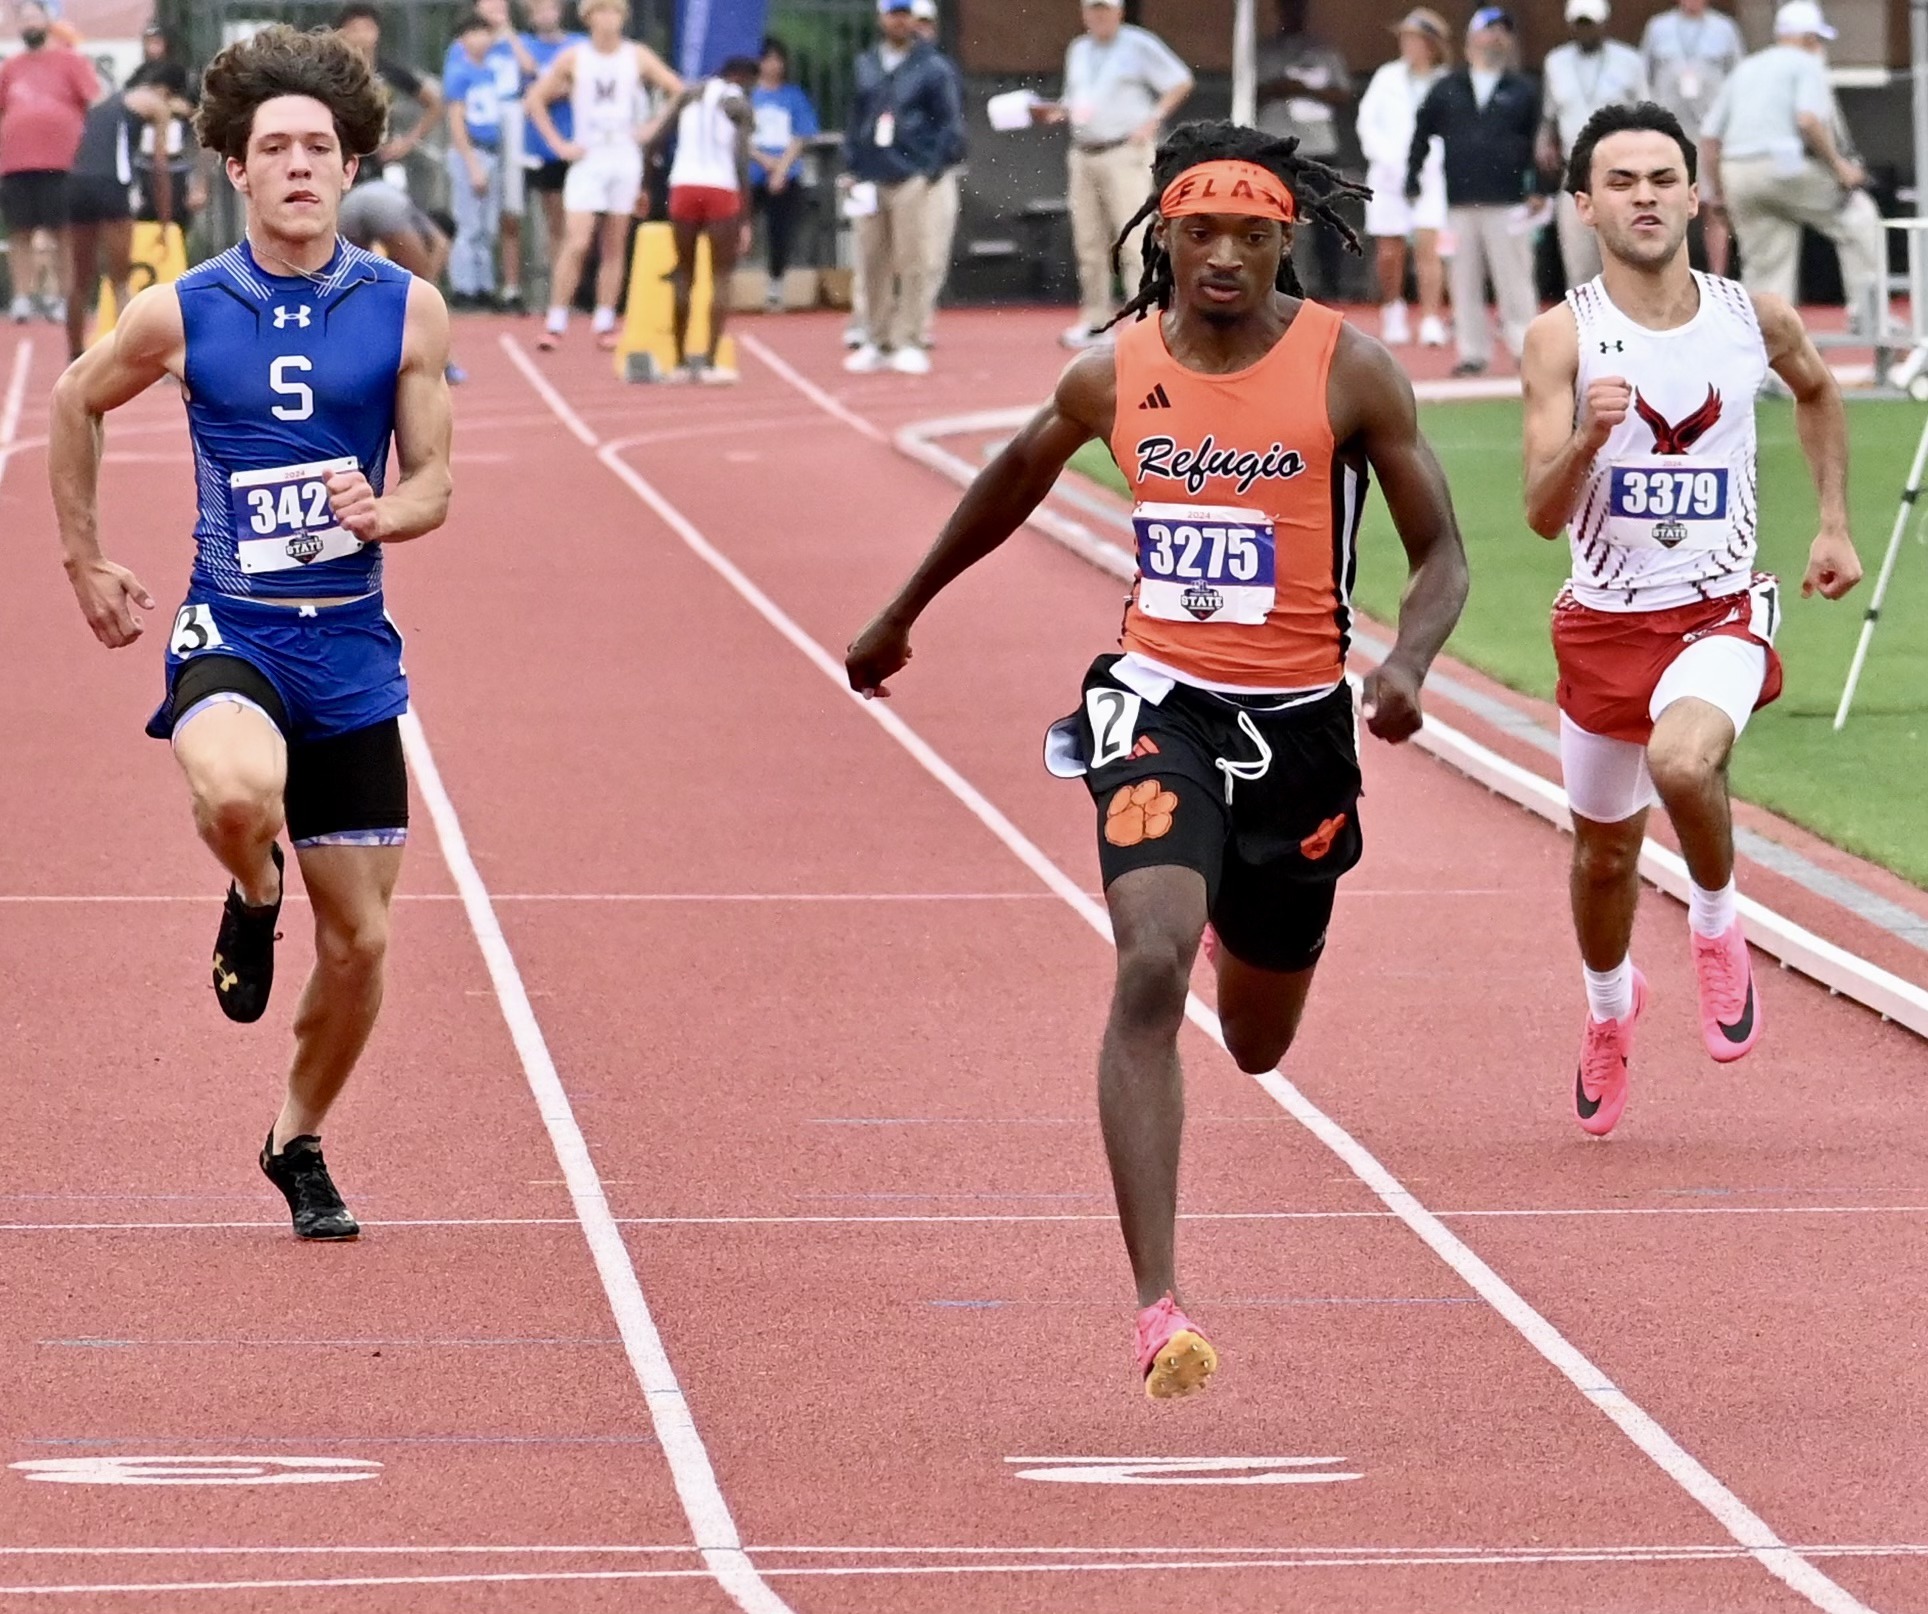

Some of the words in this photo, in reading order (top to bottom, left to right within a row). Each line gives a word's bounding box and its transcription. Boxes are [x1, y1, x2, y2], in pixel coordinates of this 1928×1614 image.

[269, 355, 314, 421] S
[285, 470, 306, 479] 2024
[1136, 434, 1306, 495] Refugio
[247, 481, 338, 535] 342
[1187, 511, 1211, 519] 2024
[1622, 471, 1718, 516] 3379
[1147, 524, 1259, 580] 3275
[1181, 596, 1223, 607] STATE
[1759, 587, 1775, 637] 1
[177, 607, 208, 652] 3
[1097, 691, 1125, 759] 2
